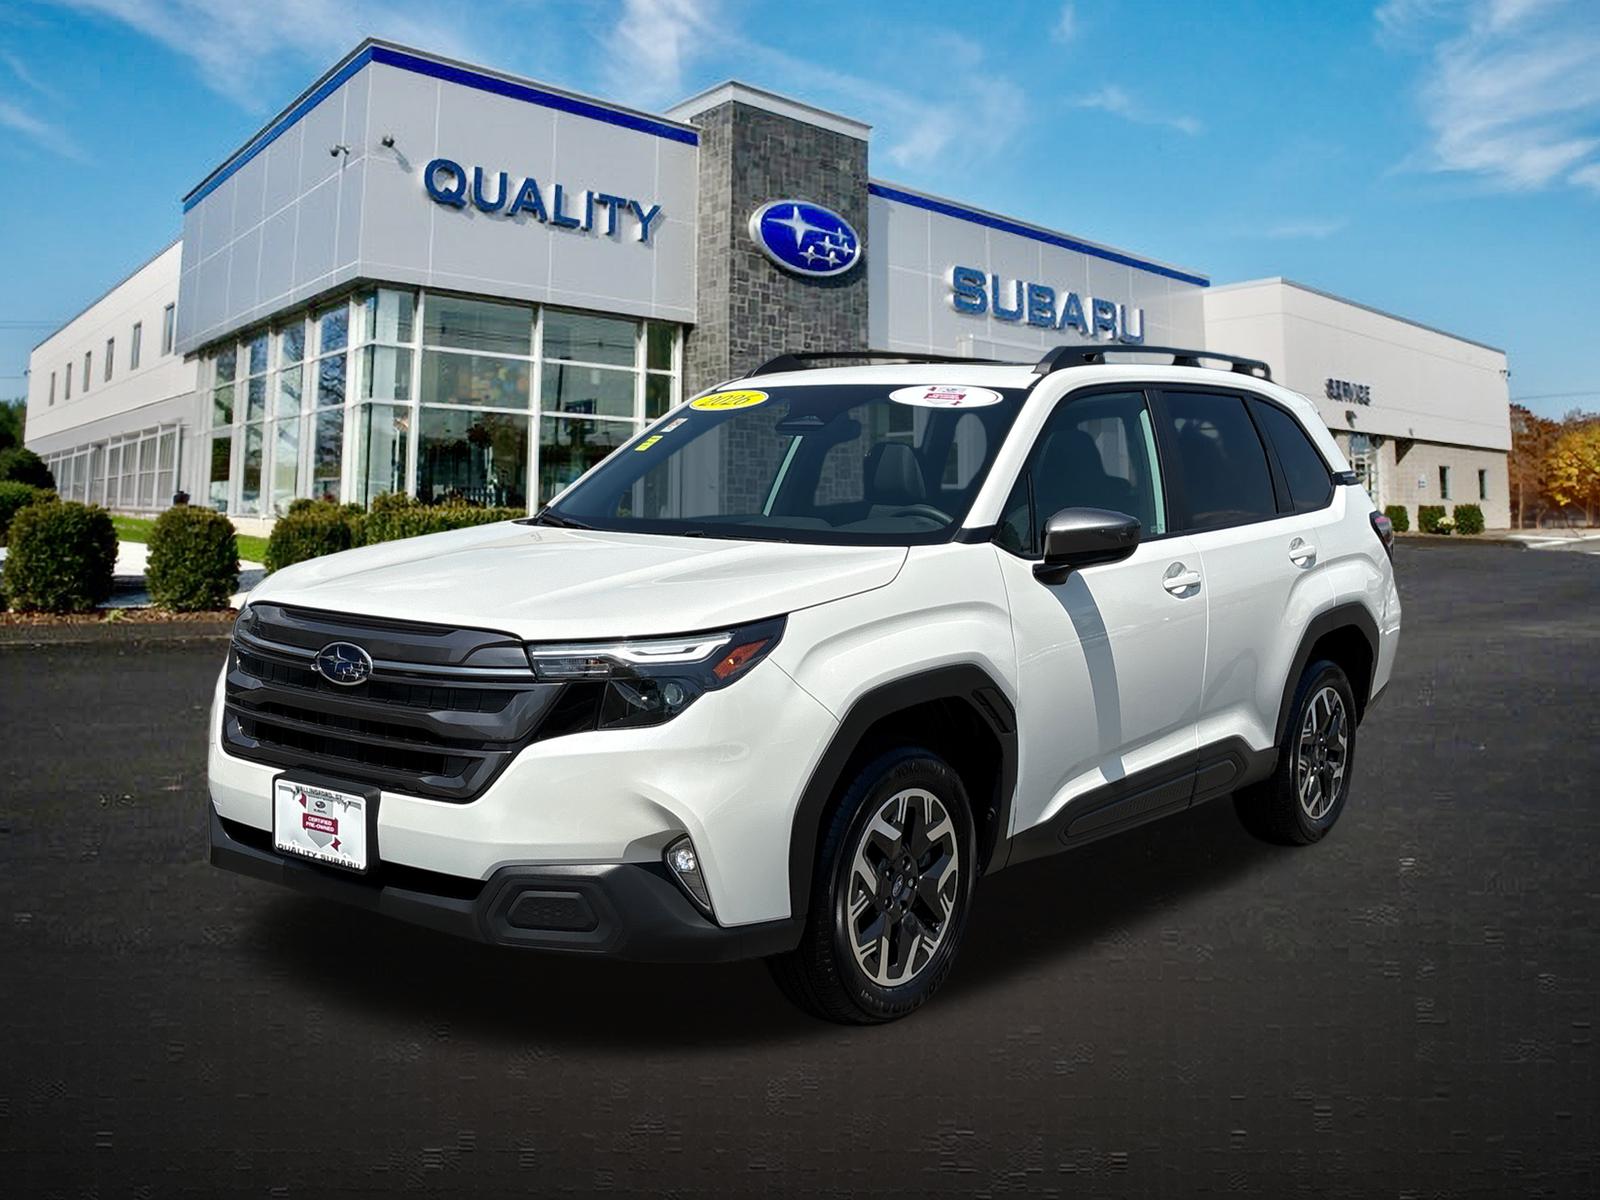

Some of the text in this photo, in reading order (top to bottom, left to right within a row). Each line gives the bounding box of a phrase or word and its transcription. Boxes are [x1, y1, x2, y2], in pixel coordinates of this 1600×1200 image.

[424, 158, 661, 242] QUALITY
[951, 265, 1145, 344] SUBARU
[1325, 377, 1371, 406] SERVICE
[305, 821, 335, 832] PRE-OWNED
[307, 816, 333, 826] CERTIFIED
[277, 843, 361, 869] QUALITY SUBARU
